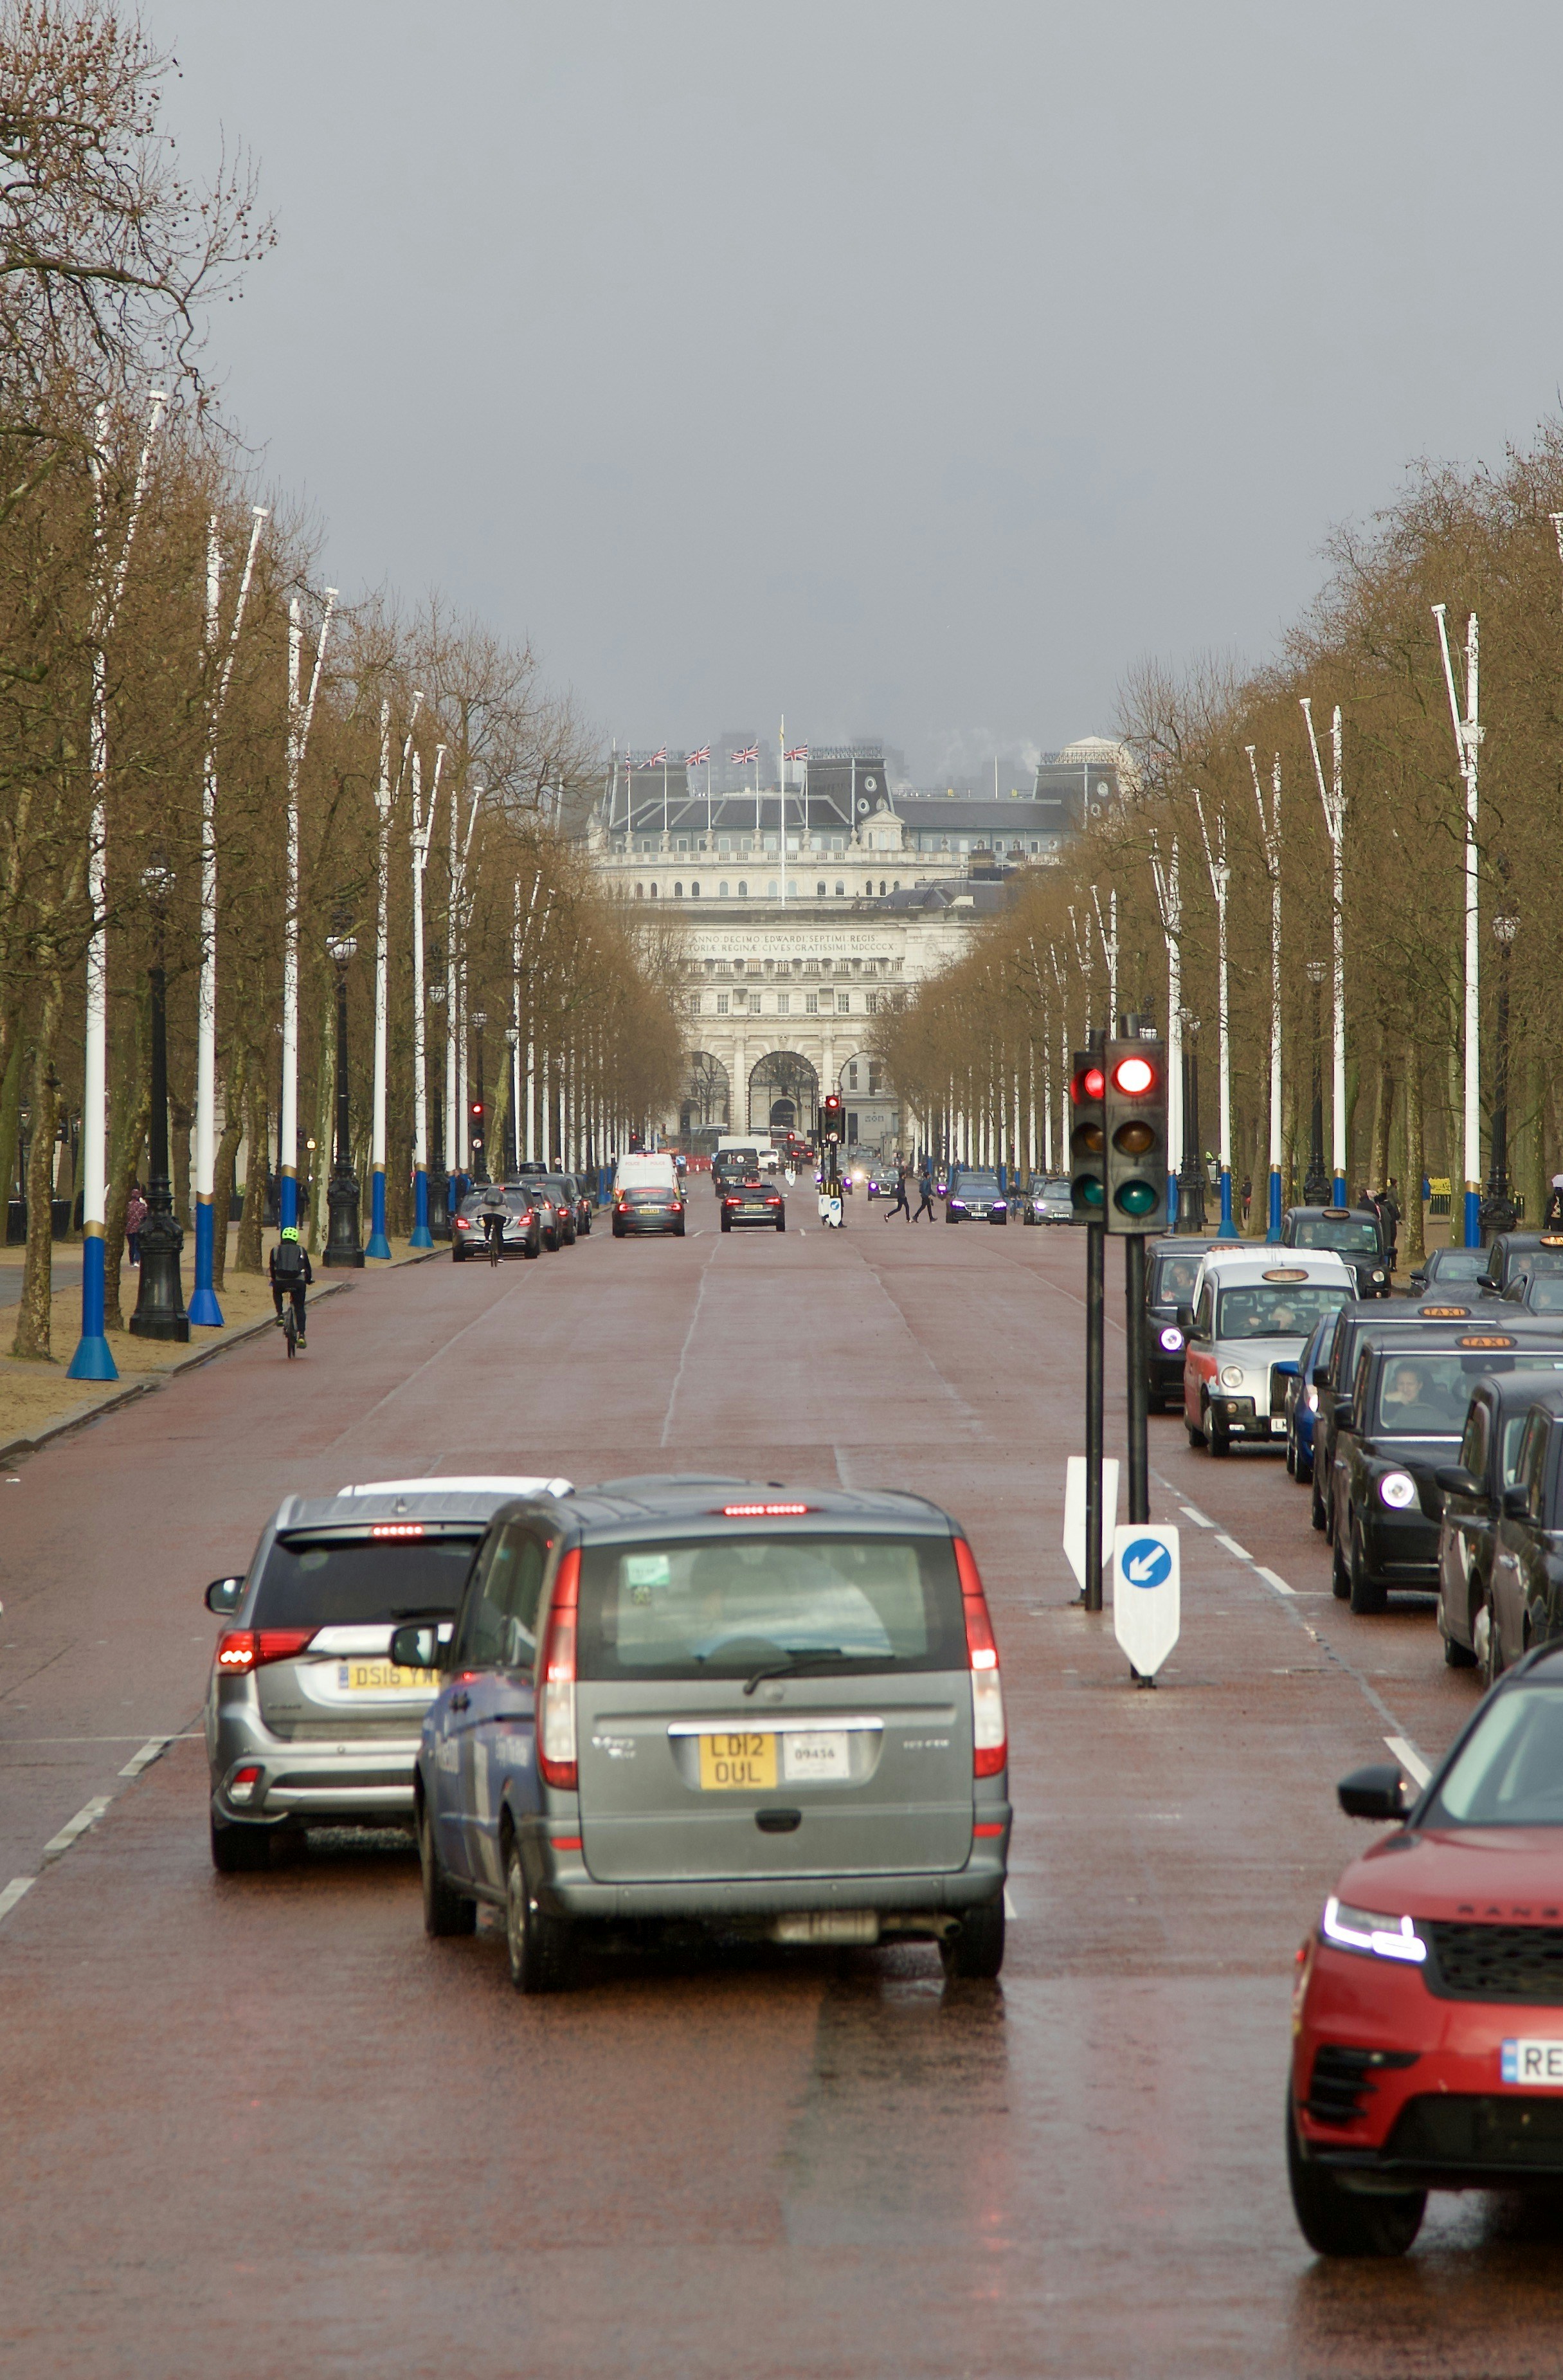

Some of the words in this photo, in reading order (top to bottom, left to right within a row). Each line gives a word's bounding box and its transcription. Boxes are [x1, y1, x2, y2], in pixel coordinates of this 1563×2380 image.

[809, 934, 845, 943] SEPTIMI
[1425, 1307, 1463, 1316] TAXI
[1463, 1337, 1508, 1347] TAXI
[356, 1666, 401, 1685] DS16
[410, 1666, 441, 1684] YW
[710, 1733, 764, 1757] LD12
[714, 1761, 762, 1783] OUL
[1525, 2048, 1563, 2076] RE
